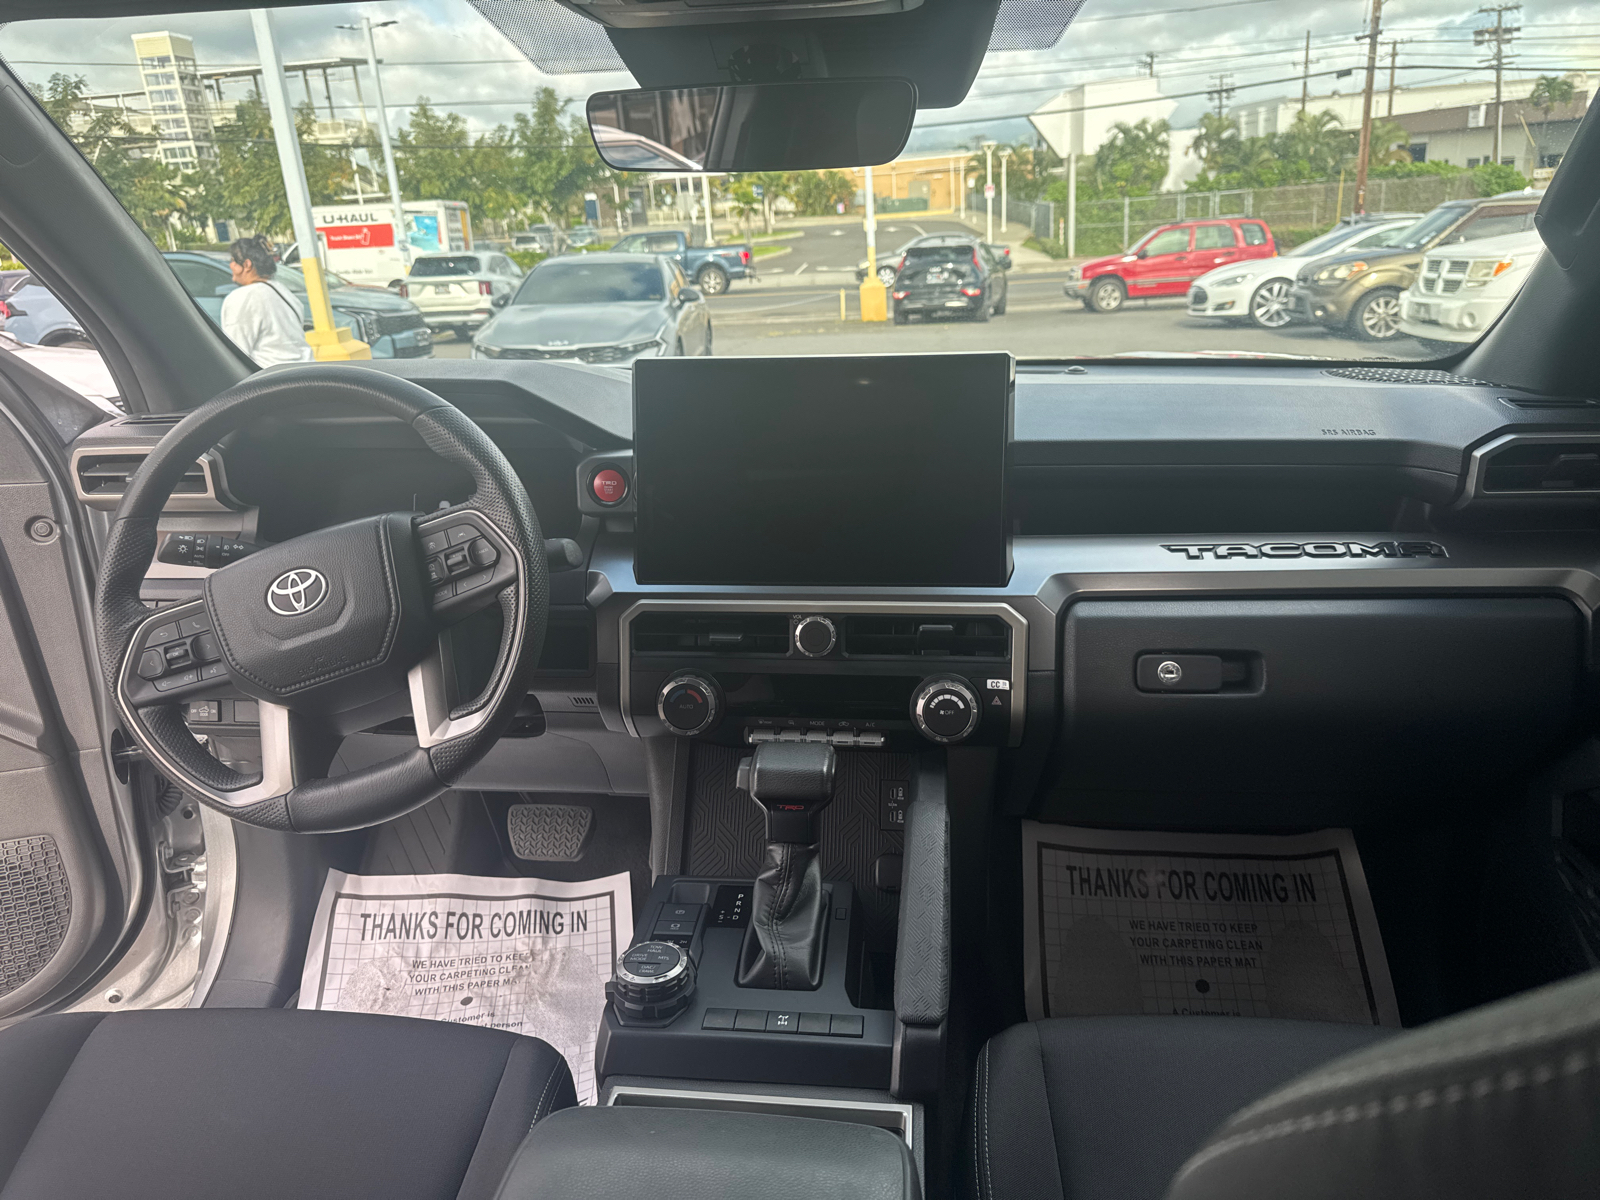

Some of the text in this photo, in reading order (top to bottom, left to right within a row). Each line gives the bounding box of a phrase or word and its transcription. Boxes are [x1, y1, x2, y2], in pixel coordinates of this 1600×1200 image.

[1159, 541, 1449, 560] TACOMA
[1066, 865, 1317, 902] THANKS FOR COMING IN
[360, 909, 588, 941] THANKS FOR COMING IN
[1129, 920, 1258, 934] WE HAVE TRIED TO KEEP
[1130, 936, 1263, 951] YOUR CARPETING CLEAN
[412, 952, 529, 969] WE HAVE TRIED TO KEE
[1139, 954, 1258, 968] WITH THIS PAPER MAT
[409, 972, 437, 983] YOUR
[439, 967, 496, 982] CARPETING
[414, 986, 440, 996] WITH
[442, 983, 465, 992] THIS
[467, 979, 500, 990] PAPER
